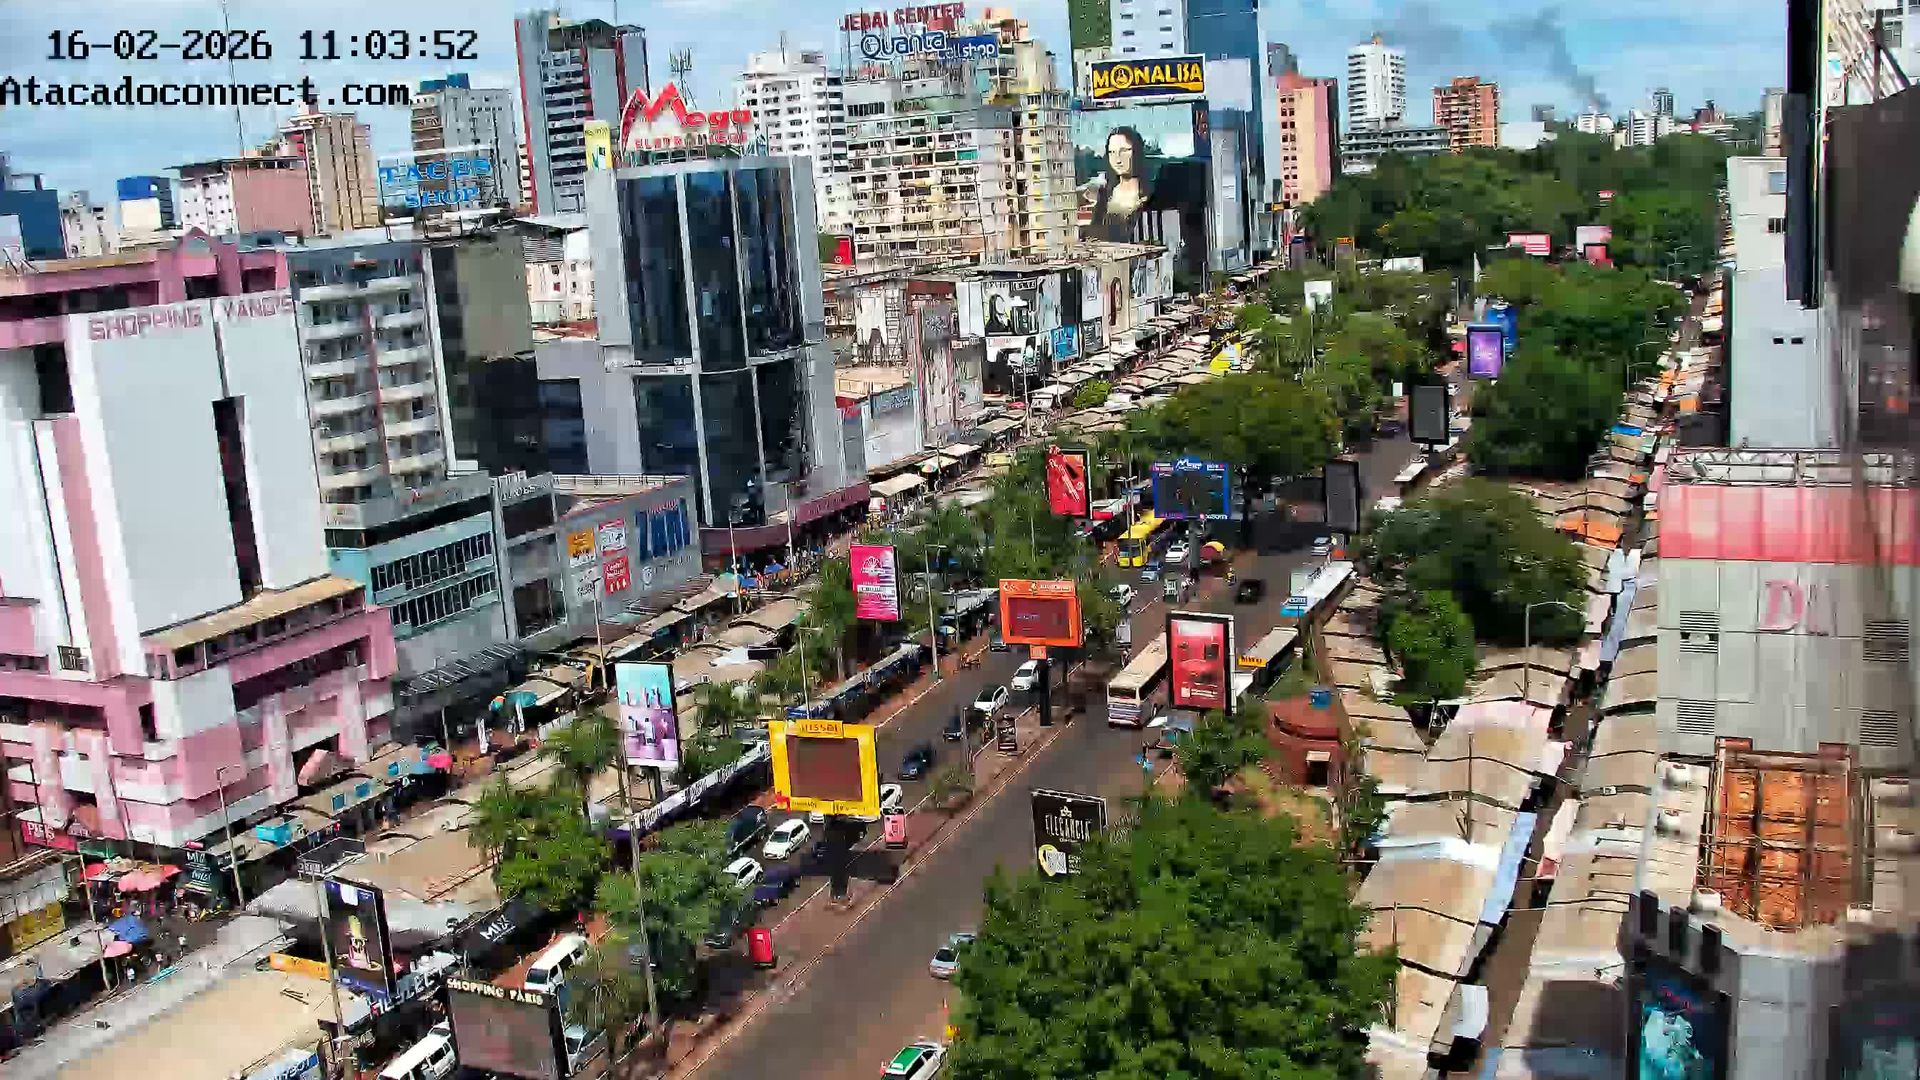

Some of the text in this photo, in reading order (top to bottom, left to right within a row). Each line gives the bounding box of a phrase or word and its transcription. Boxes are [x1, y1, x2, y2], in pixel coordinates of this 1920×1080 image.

[860, 31, 947, 60] Quanta
[1093, 62, 1203, 89] MONALISA
[405, 186, 480, 208] SHOP
[88, 305, 203, 340] SHOPPING
[480, 914, 511, 940] MIX
[446, 977, 543, 1005] SHOPPING PARIS
